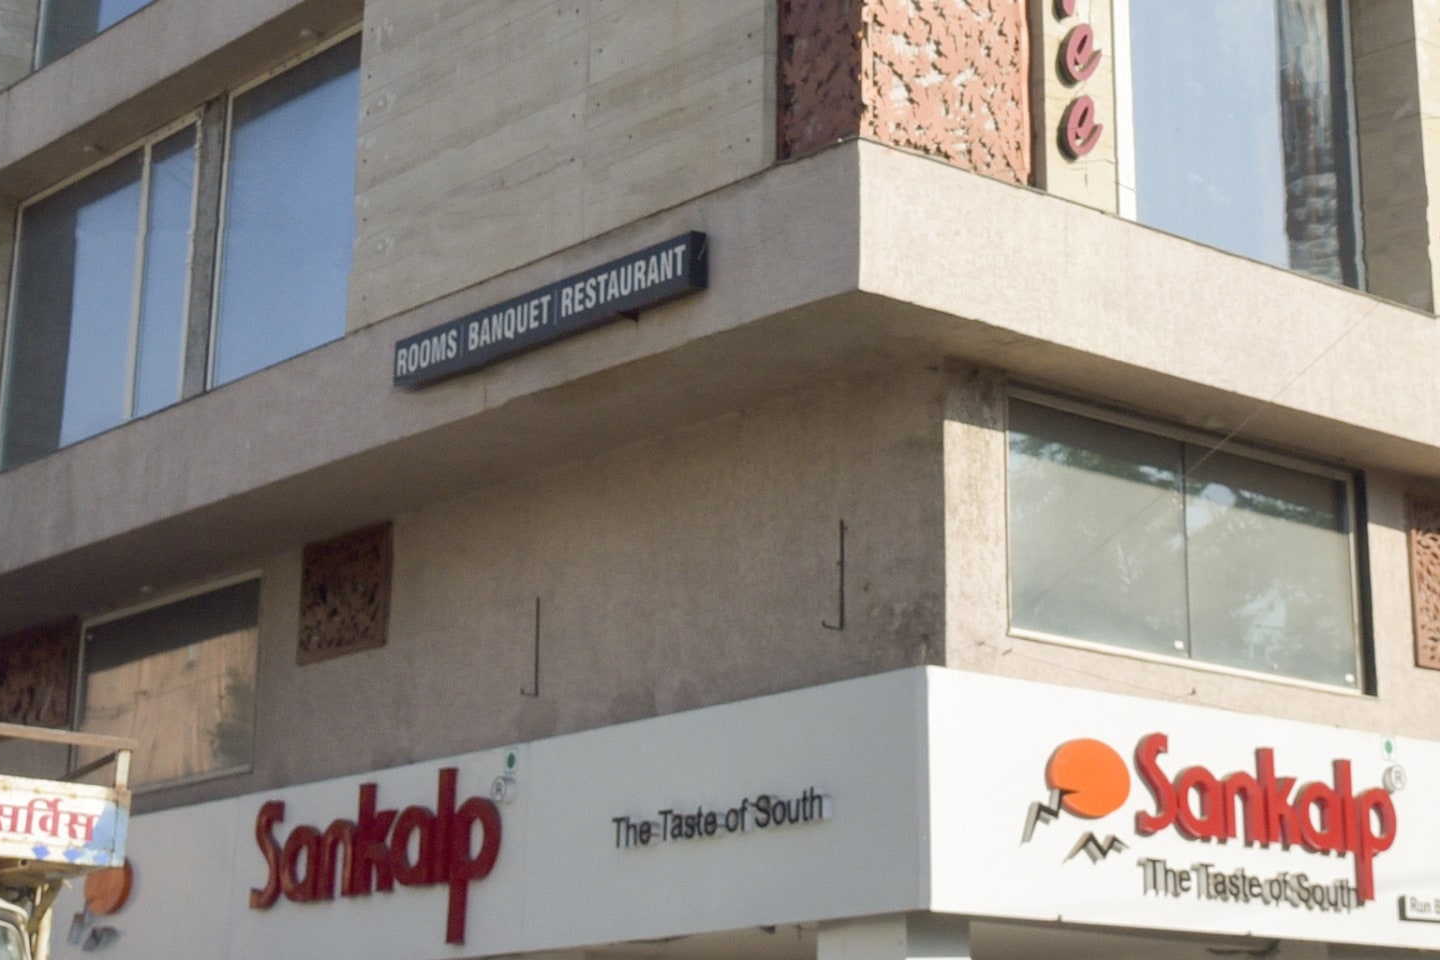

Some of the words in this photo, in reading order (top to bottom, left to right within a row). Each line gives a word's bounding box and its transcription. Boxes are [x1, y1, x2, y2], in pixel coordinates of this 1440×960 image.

[396, 329, 458, 377] ROOMS
[468, 294, 551, 351] BANQUET
[561, 244, 687, 318] RESTAURANT
[249, 766, 502, 945] Sankalp
[612, 816, 652, 848] The
[659, 806, 717, 841] Taste
[726, 798, 748, 833] of
[755, 786, 823, 828] South
[1134, 732, 1397, 905] Sankalp
[1138, 858, 1192, 897] The
[1192, 863, 1261, 903] Taste
[1262, 871, 1289, 906] of
[1291, 873, 1364, 912] South
